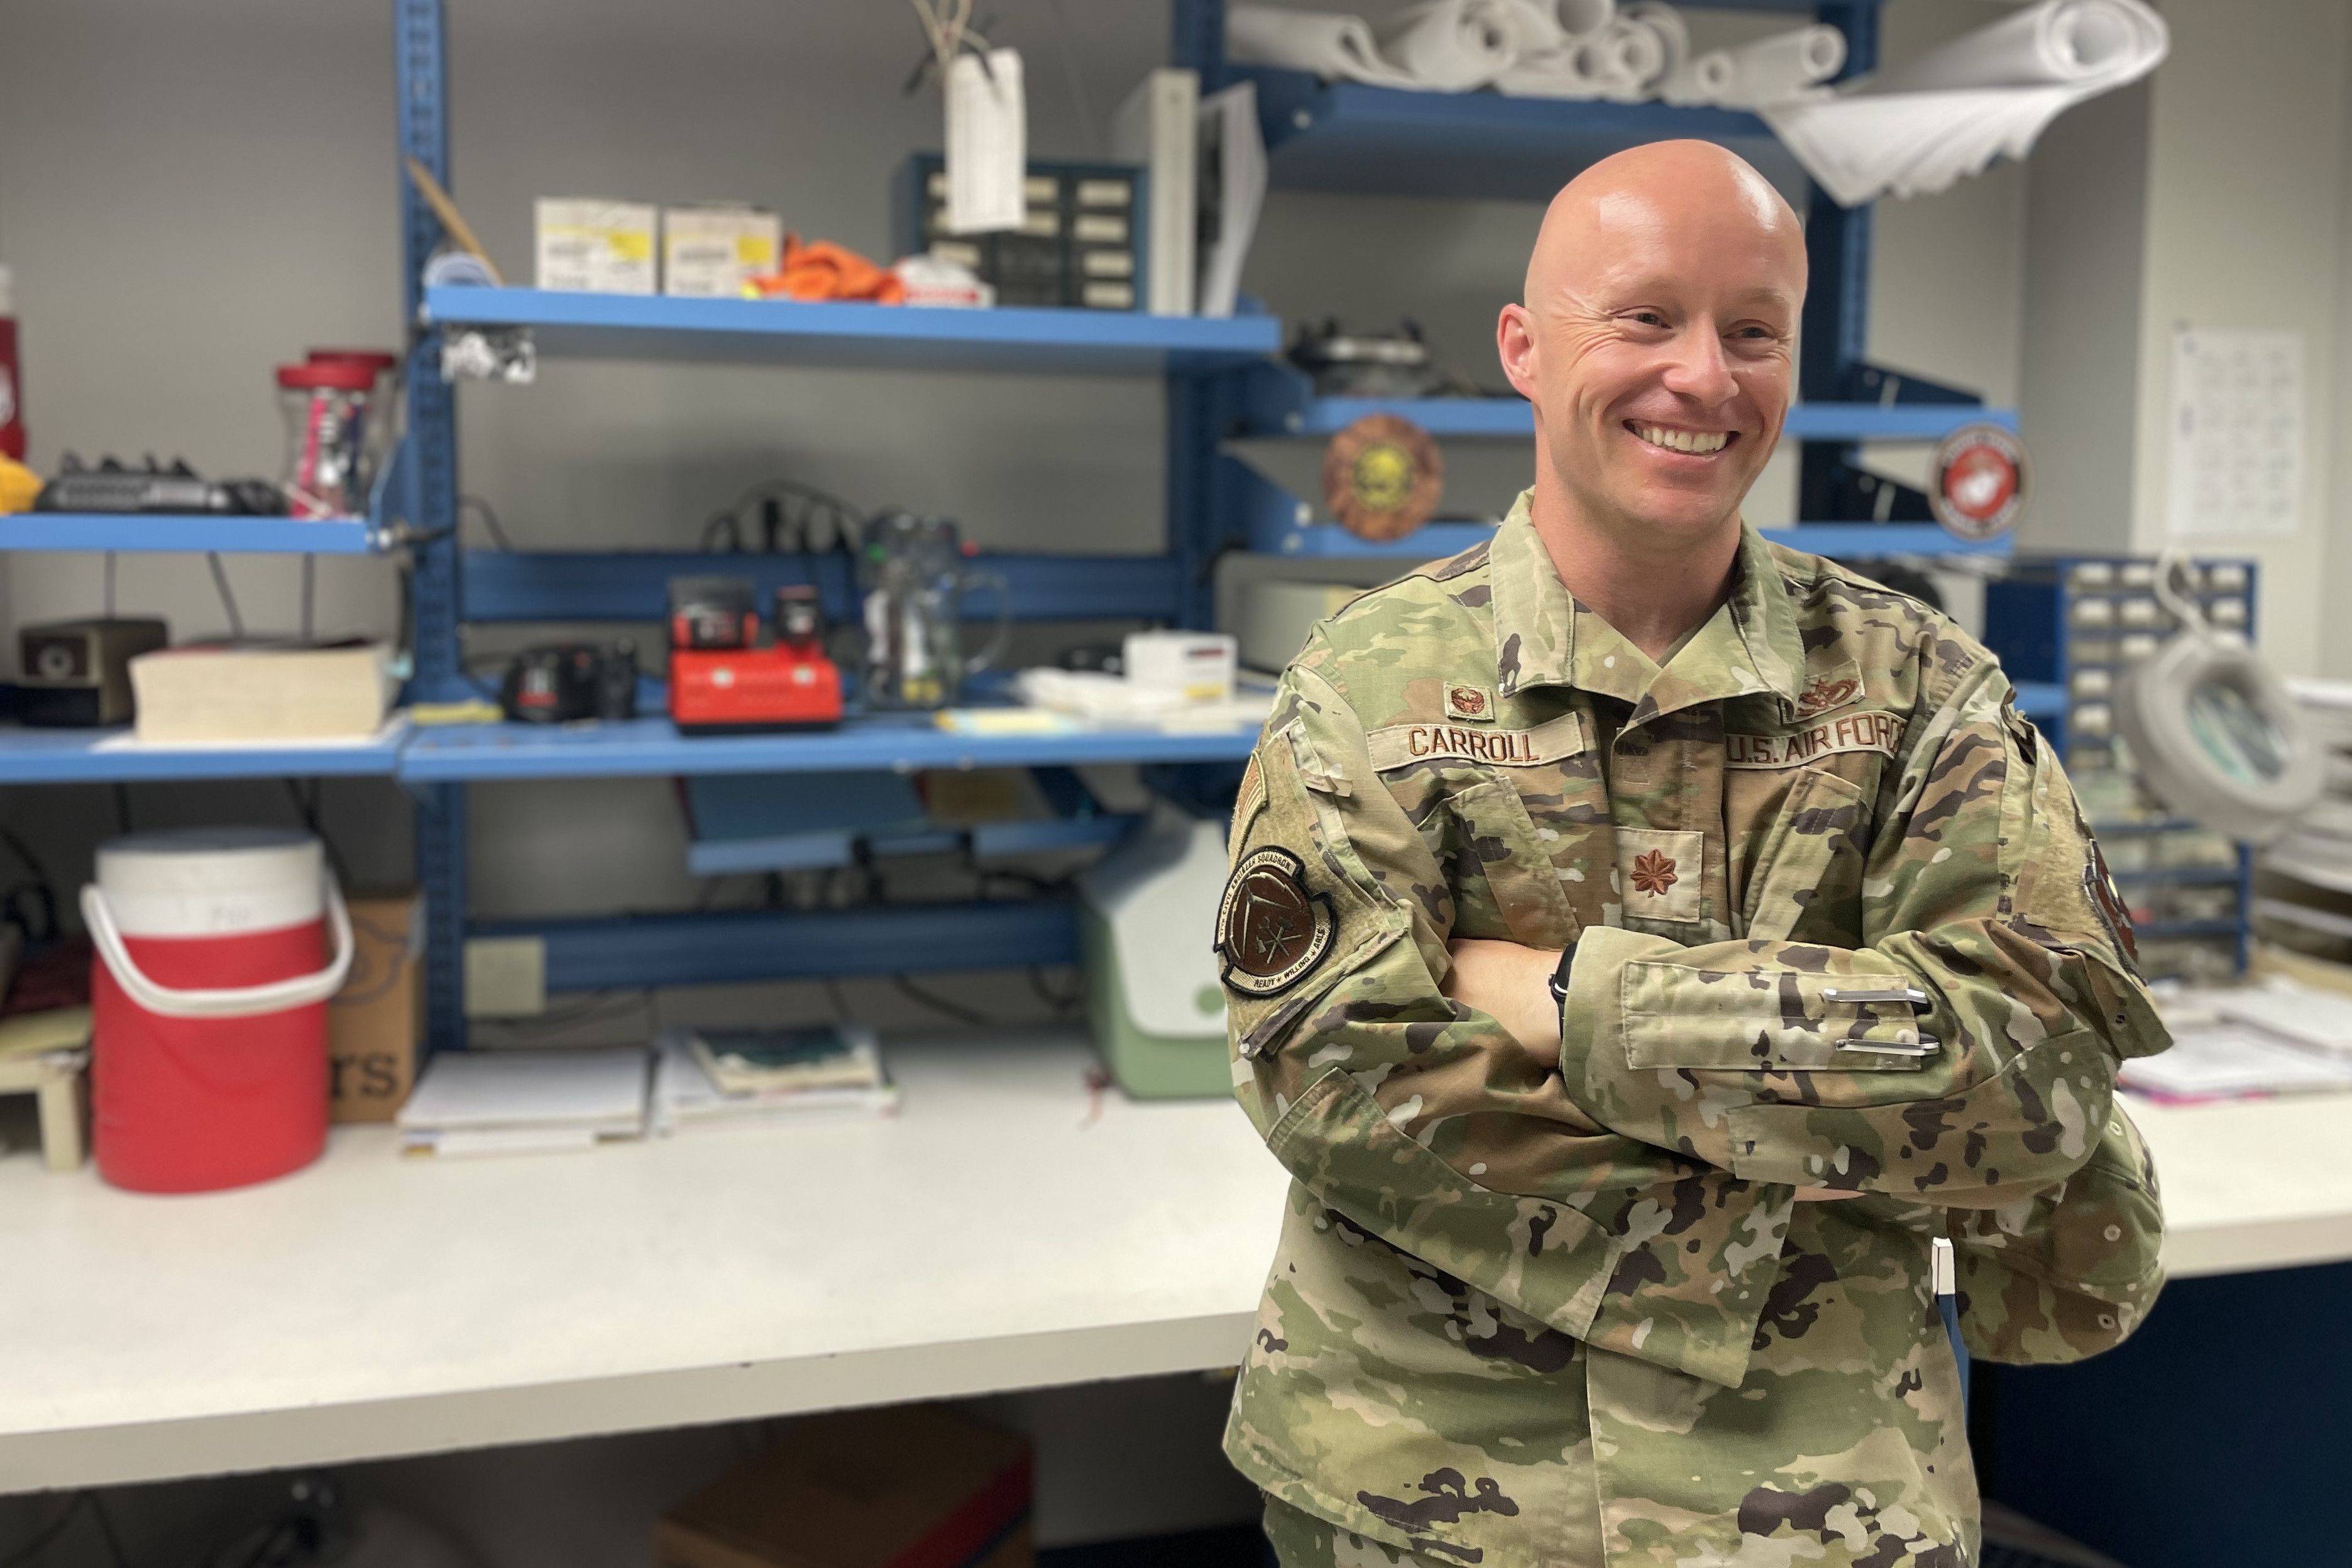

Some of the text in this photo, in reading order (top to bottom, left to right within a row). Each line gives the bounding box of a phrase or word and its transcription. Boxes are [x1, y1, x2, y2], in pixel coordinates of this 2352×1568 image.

[1409, 727, 1539, 762] CARROLL
[1726, 737, 1779, 764] U.S.
[1785, 725, 1832, 762] AIR
[1258, 854, 1292, 870] SQUADRON
[1254, 927, 1326, 988] READY WILLING ABLE
